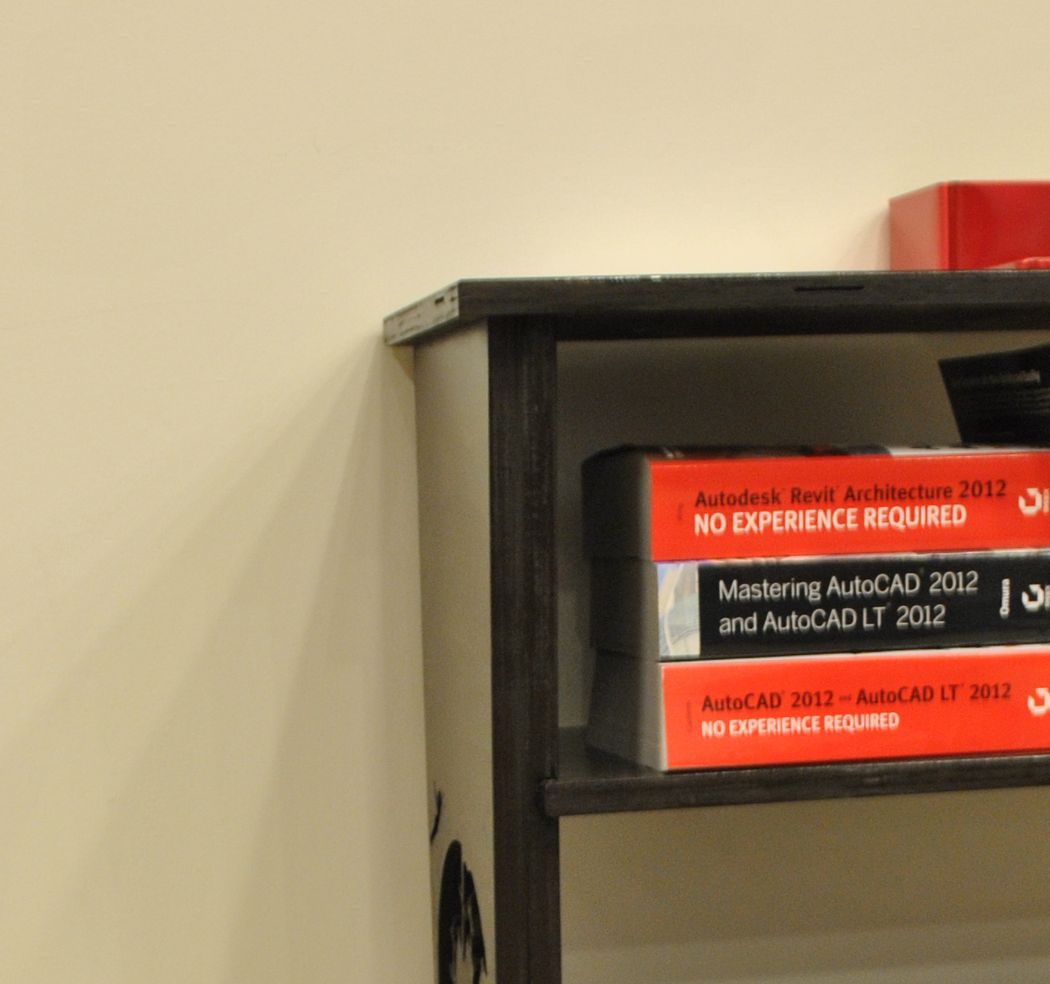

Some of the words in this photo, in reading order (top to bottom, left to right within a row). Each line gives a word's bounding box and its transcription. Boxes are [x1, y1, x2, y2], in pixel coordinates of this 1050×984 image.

[695, 488, 781, 507] Autodesk
[791, 486, 835, 504] Revit
[844, 483, 953, 501] Architecture
[959, 479, 1007, 498] 2012
[694, 512, 727, 535] NO
[732, 508, 859, 533] EXPERIENCE
[864, 504, 967, 531] REQUIRED
[719, 578, 821, 602] Mastering
[827, 573, 921, 598] AutoCAD
[928, 570, 979, 595] 2012
[719, 612, 757, 635] and
[763, 608, 857, 632] AutoCAD
[862, 606, 887, 629] LT
[896, 604, 946, 629] 2012
[701, 692, 782, 712] AutoCAD
[790, 690, 834, 708] 2012
[856, 685, 935, 706] AutoCAD
[940, 685, 958, 702] LT
[969, 682, 1012, 701] 2012
[701, 720, 726, 738] NO
[729, 715, 820, 736] EXPERIENCE
[824, 712, 900, 733] REQUIRED
